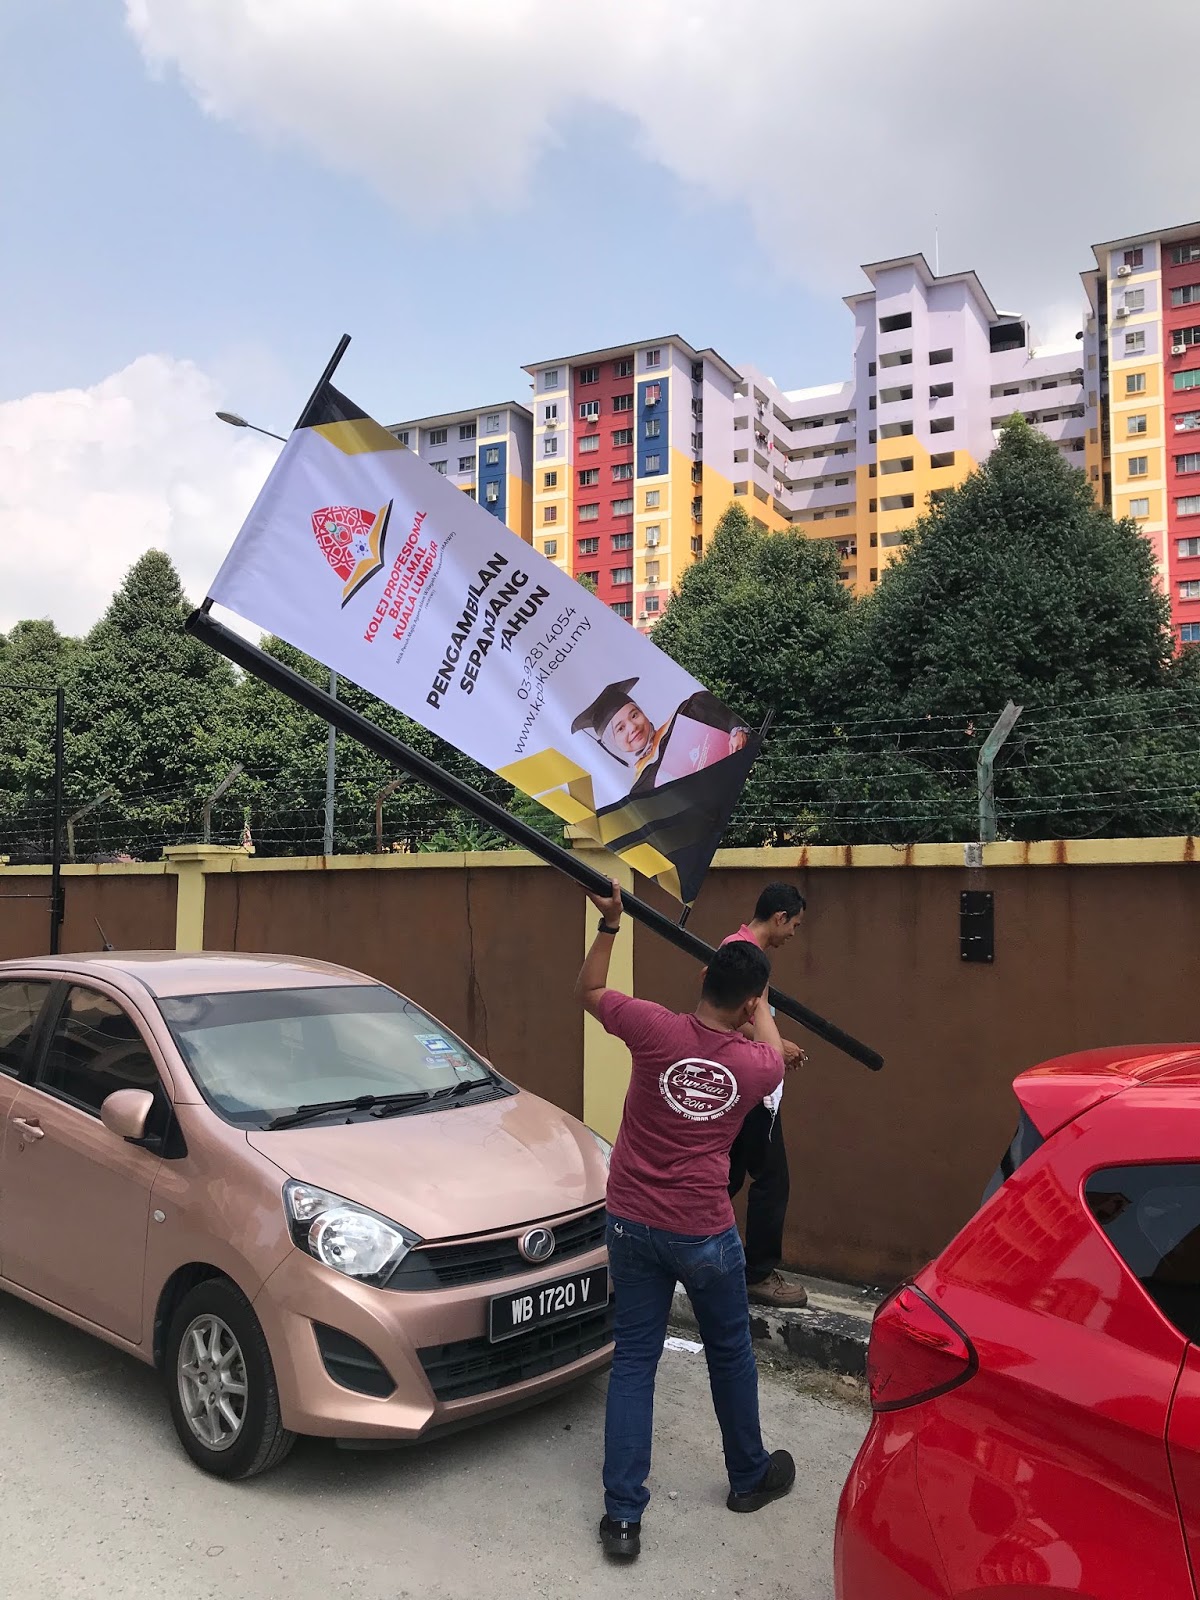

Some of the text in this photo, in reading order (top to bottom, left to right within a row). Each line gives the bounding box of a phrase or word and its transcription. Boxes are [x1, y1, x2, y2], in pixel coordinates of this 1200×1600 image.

[363, 510, 428, 643] KOLEJ PROFESIONAL
[388, 546, 428, 620] BAITULMAL
[392, 594, 418, 641] KUALA
[414, 540, 439, 595] LUMPUR
[426, 551, 510, 710] PENGAMBILAN
[460, 569, 529, 695] SEPANJANG
[500, 585, 550, 653] TAHUN
[516, 606, 577, 700] 03-92814054
[671, 1073, 726, 1096] Qurban
[682, 1097, 706, 1110] 2016
[511, 1277, 591, 1325] WB 1720 V
